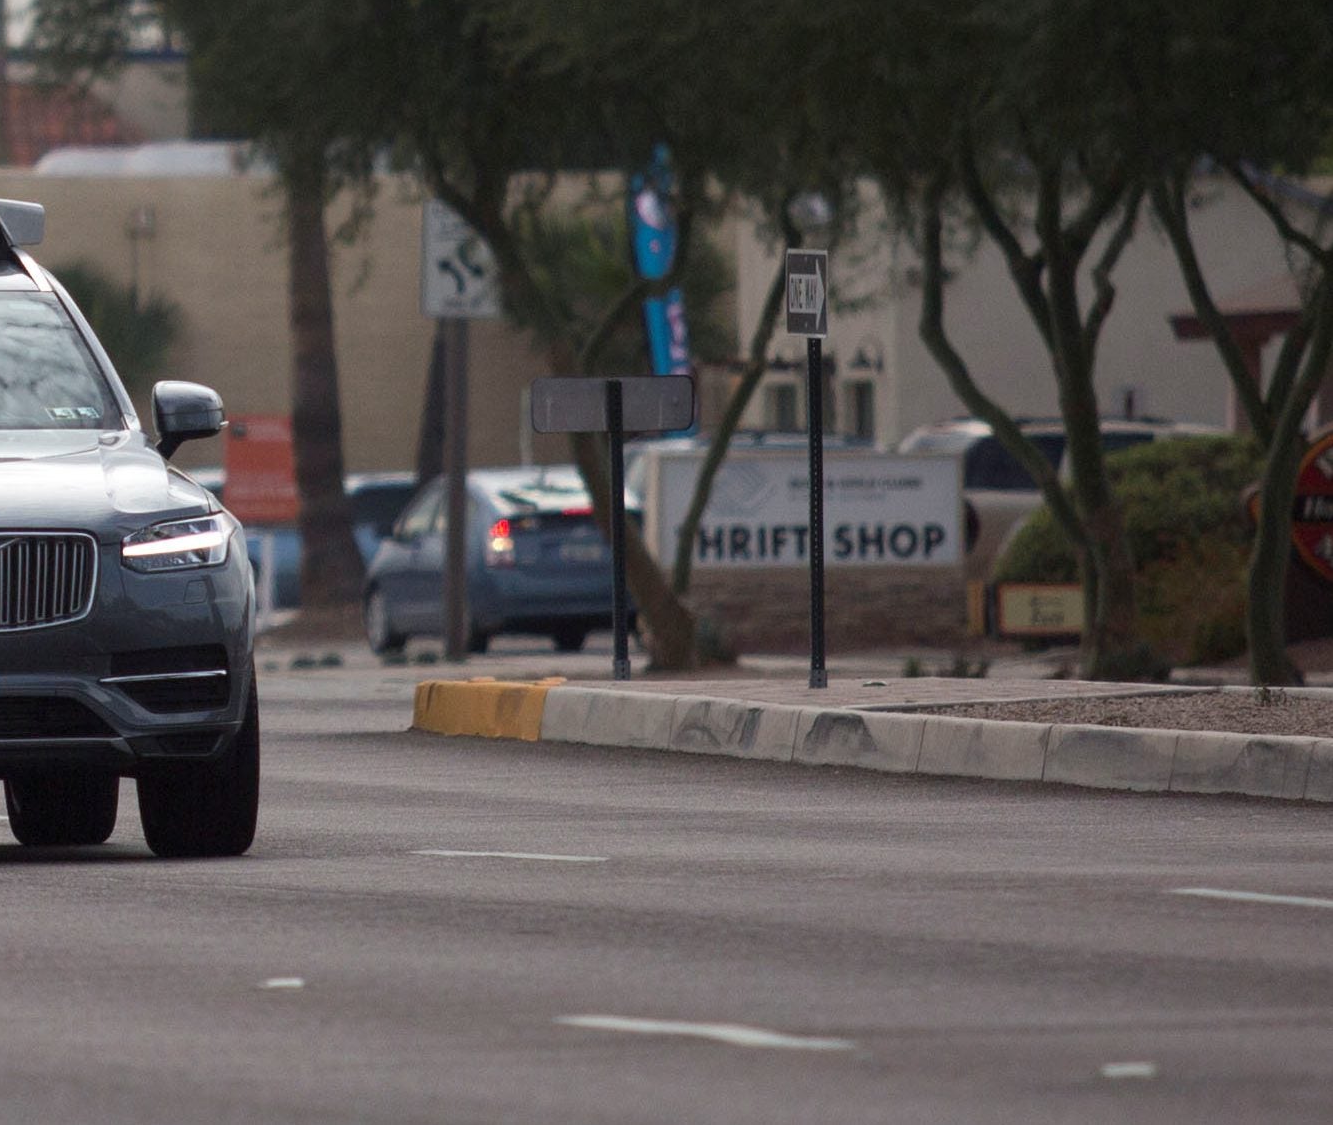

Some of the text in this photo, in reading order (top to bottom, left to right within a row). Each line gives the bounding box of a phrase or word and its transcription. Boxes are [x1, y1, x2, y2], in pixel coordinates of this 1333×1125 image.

[790, 277, 818, 309] ONE WAY
[674, 524, 945, 560] HRIFT SHOP
